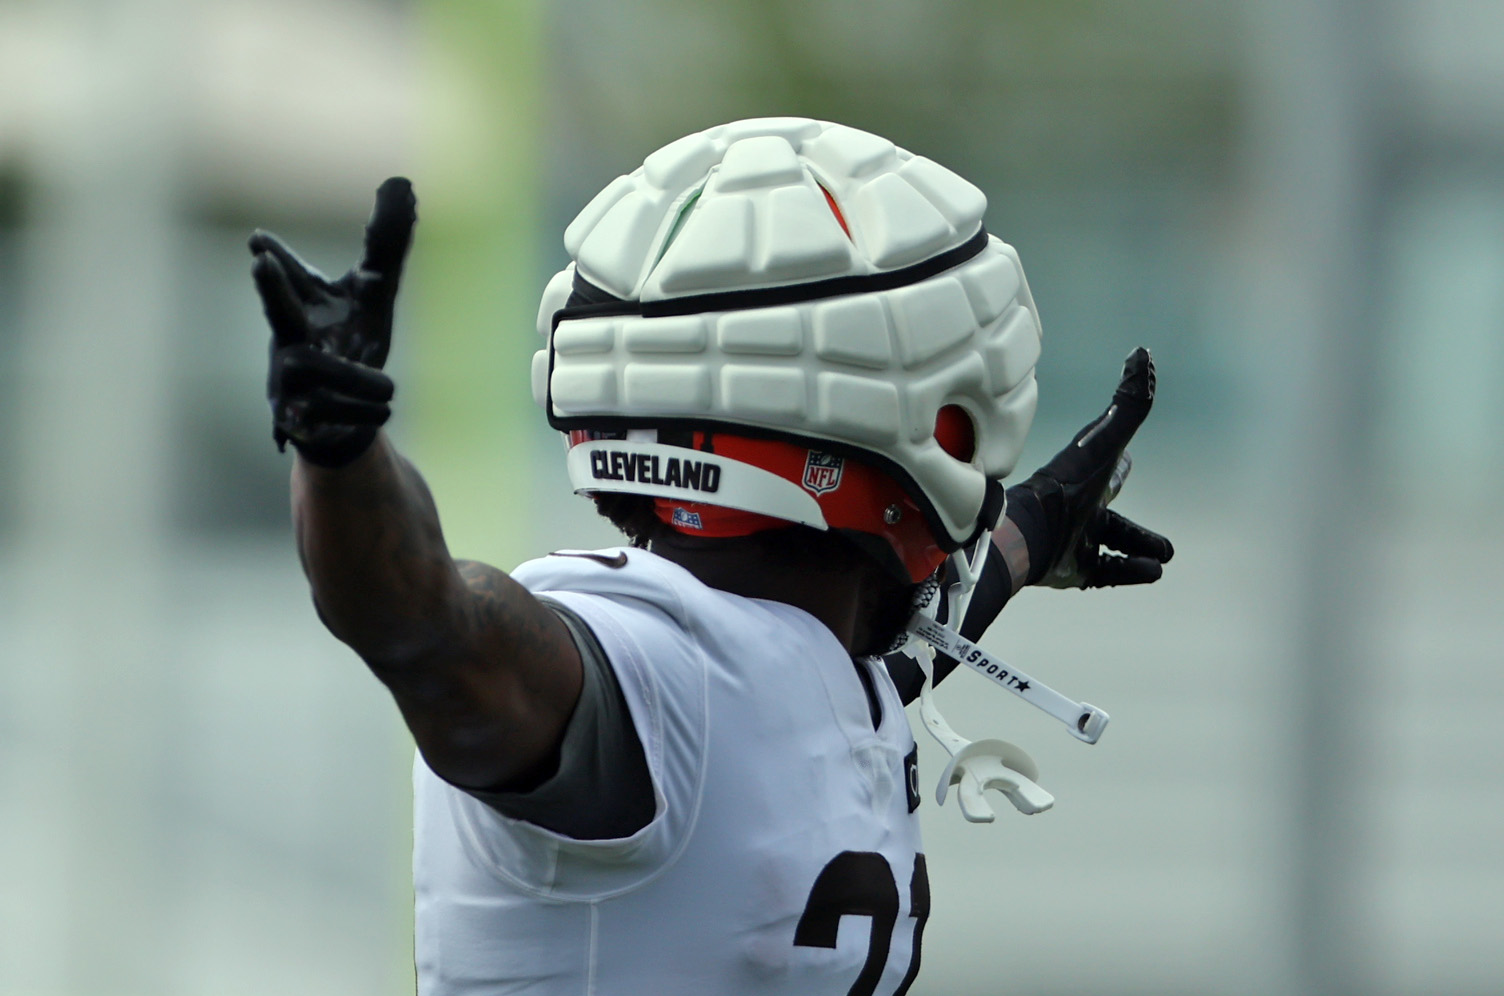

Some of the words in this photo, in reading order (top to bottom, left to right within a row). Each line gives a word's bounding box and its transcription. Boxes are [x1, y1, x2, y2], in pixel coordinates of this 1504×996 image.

[590, 450, 721, 493] CLEVELAND
[809, 466, 835, 487] NFL
[966, 650, 1018, 686] SPORT
